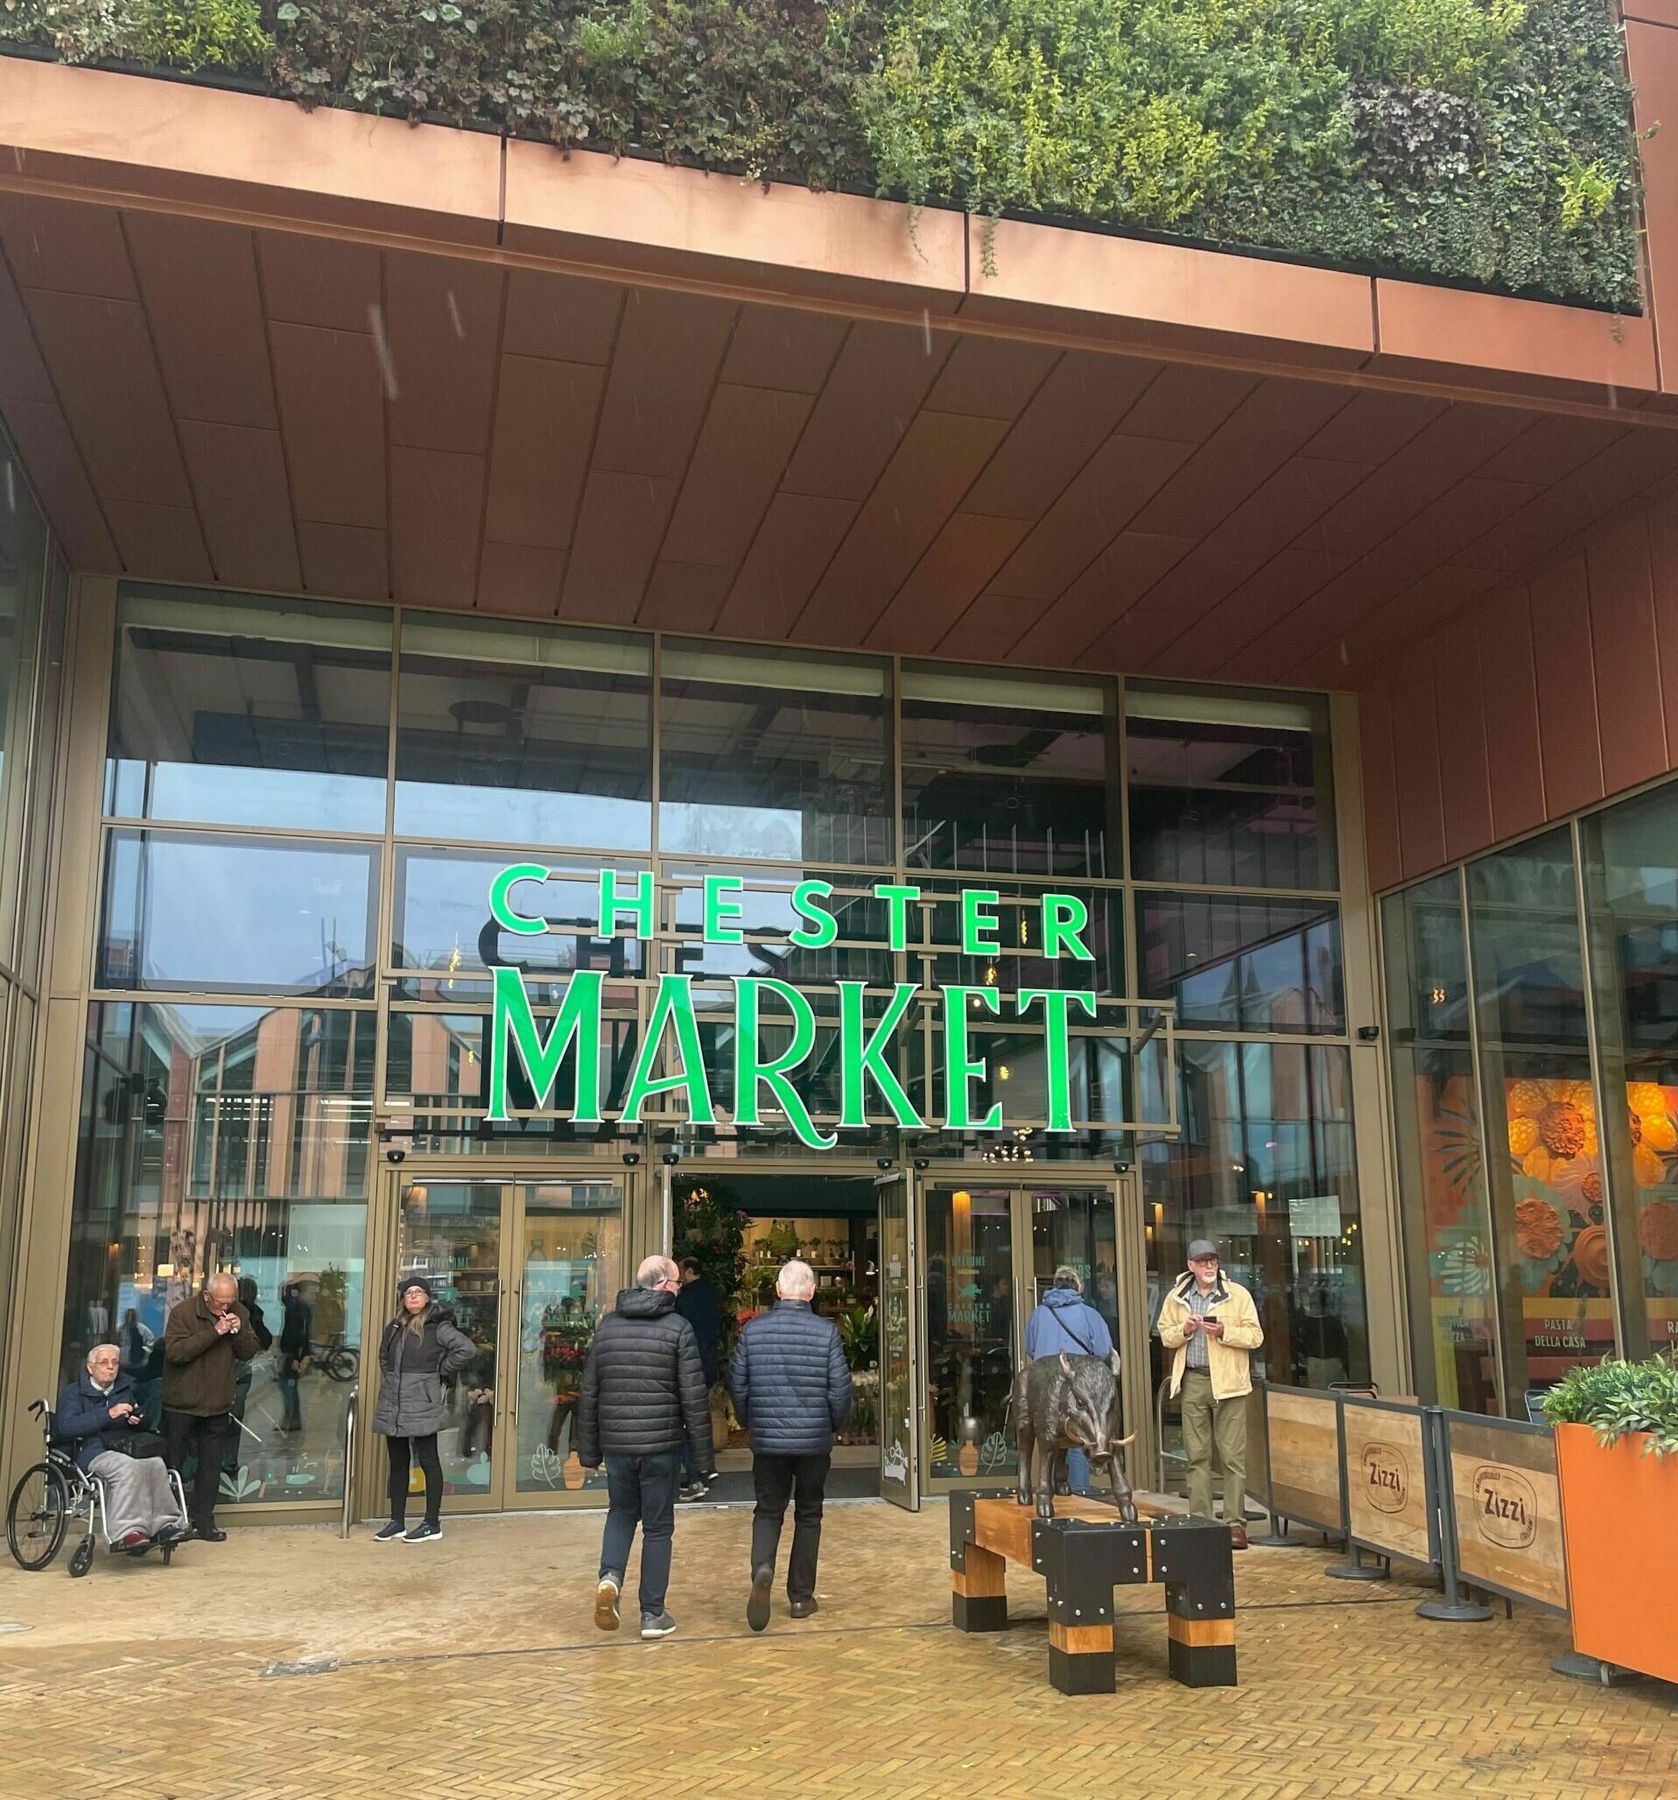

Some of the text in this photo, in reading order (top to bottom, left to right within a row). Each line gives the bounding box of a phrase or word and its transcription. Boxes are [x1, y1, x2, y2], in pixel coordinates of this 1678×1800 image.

[488, 862, 1097, 962] CHESTER
[482, 965, 1098, 1151] MARKET
[948, 1310, 991, 1323] MARKET
[1544, 1318, 1573, 1331] PASTA
[1534, 1334, 1587, 1349] DELLA CASA
[1369, 1462, 1401, 1492] Zizzi
[1484, 1487, 1526, 1526] Zizzi
